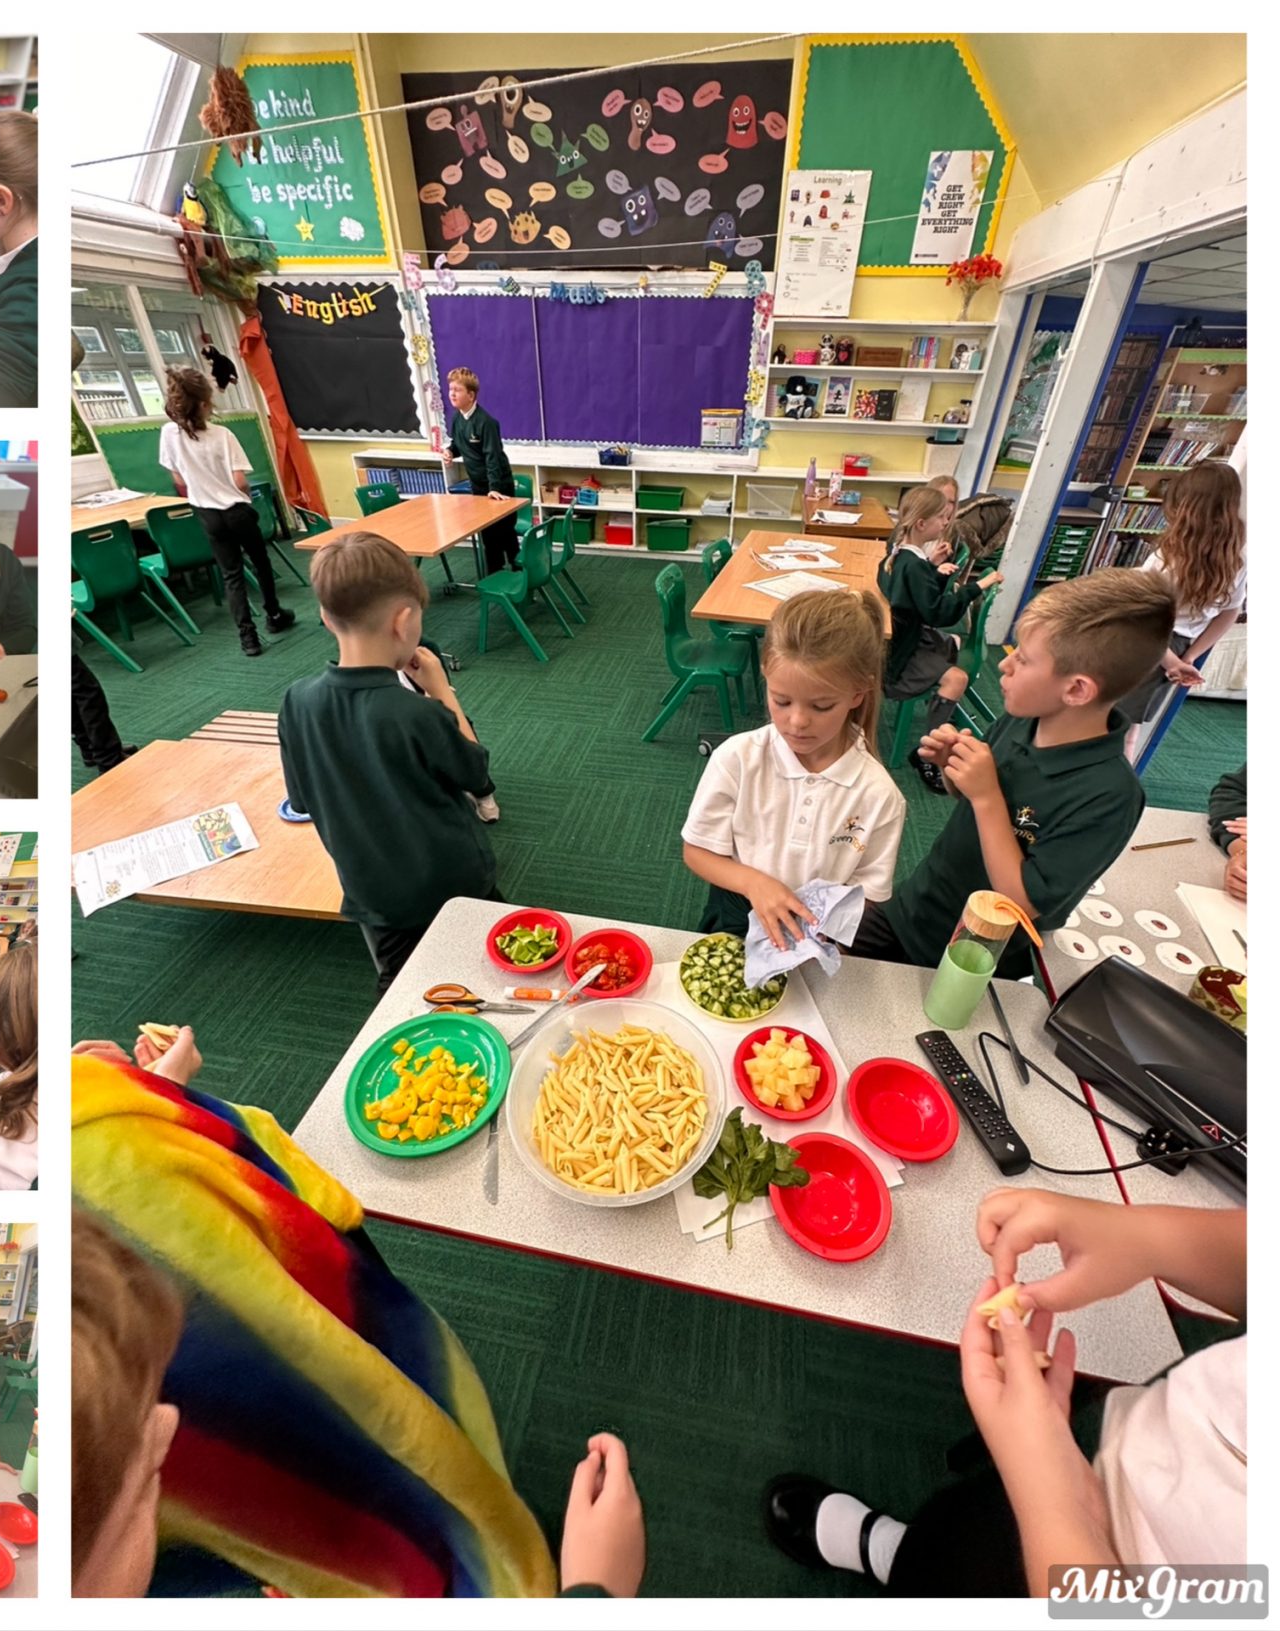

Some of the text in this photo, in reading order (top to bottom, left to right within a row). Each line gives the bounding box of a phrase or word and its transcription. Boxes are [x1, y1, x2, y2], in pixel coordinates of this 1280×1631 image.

[268, 88, 316, 118] kind
[269, 133, 344, 173] helpful
[813, 175, 843, 186] Learning
[246, 174, 354, 211] be specific
[946, 185, 963, 193] GET
[941, 193, 965, 201] CREW
[938, 202, 964, 210] RIGHT
[941, 210, 958, 218] GET
[921, 218, 974, 226] EVERYTHING
[933, 226, 959, 234] RIGHT
[704, 260, 728, 298] 7
[744, 260, 767, 297] 8
[291, 287, 377, 325] English
